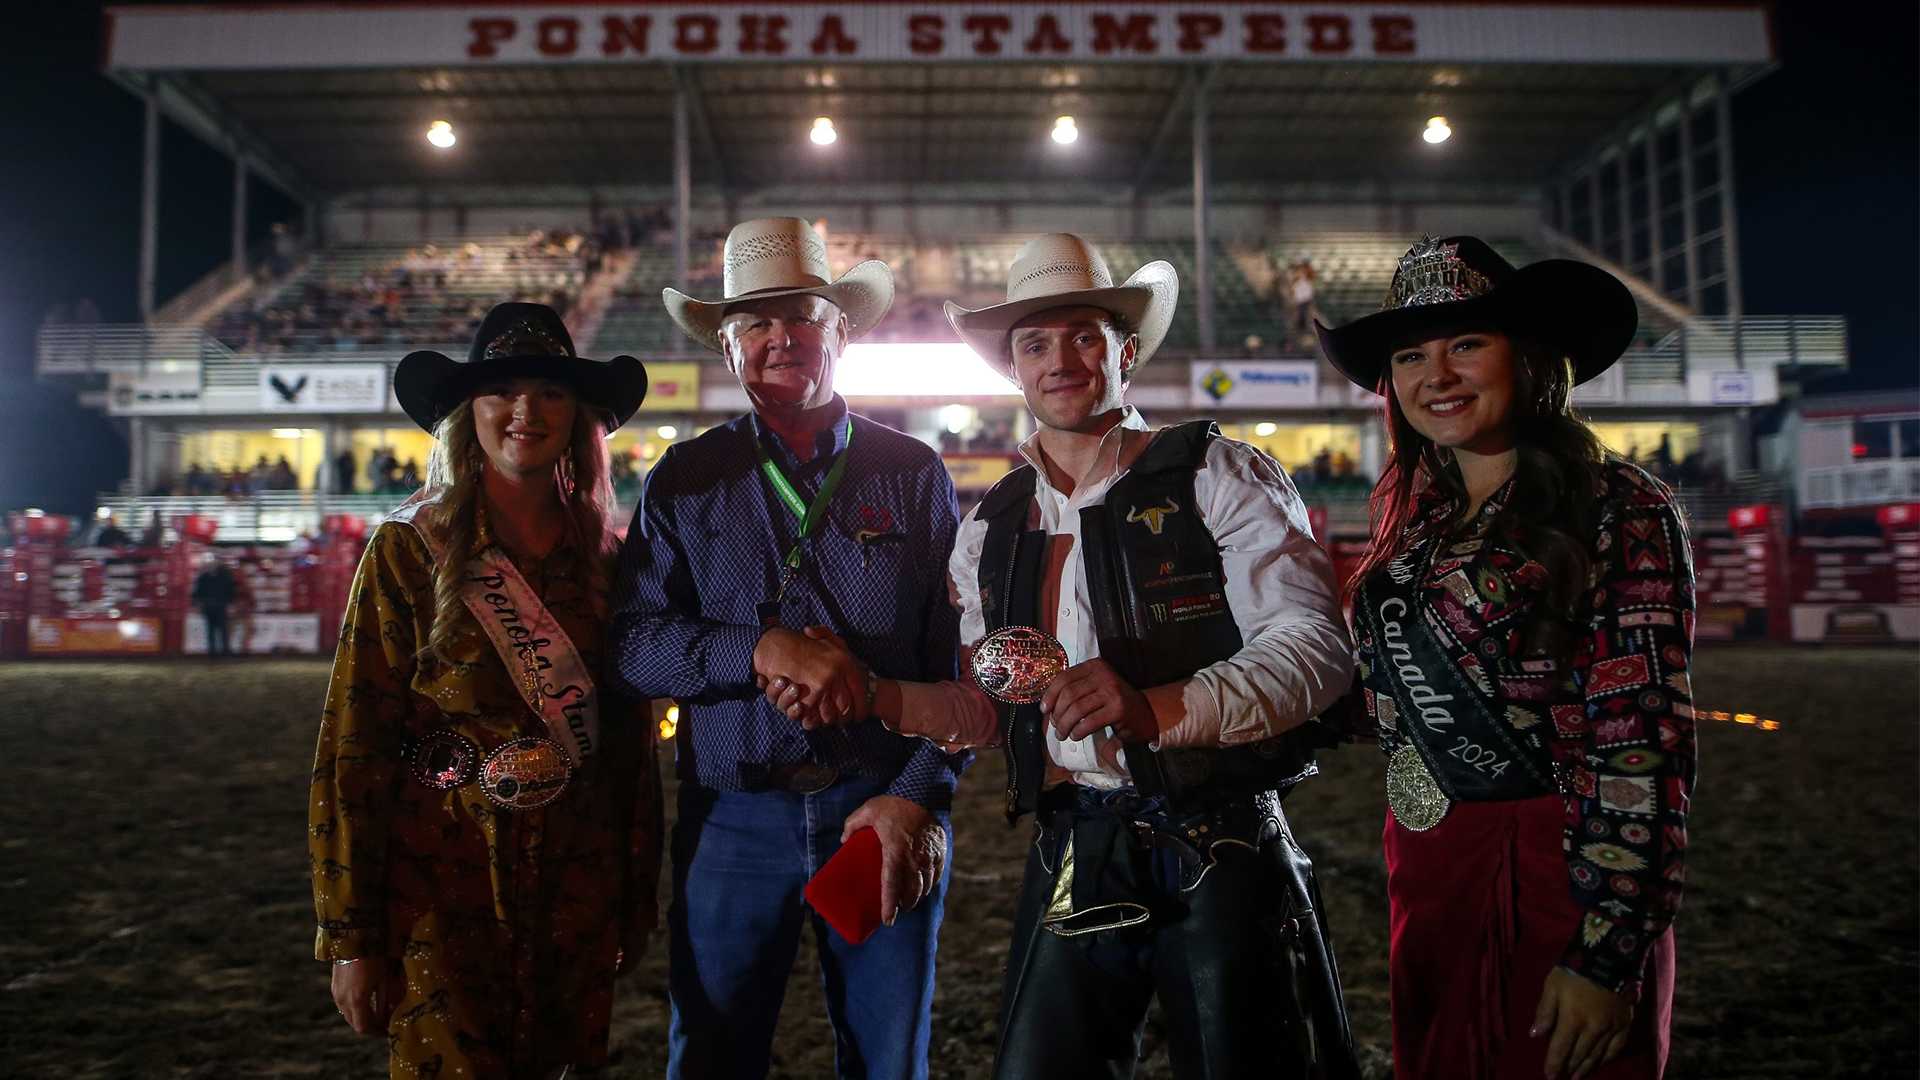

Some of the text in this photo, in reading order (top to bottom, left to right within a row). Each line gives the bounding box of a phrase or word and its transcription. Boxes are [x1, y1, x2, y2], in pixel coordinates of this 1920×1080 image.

[467, 12, 1417, 57] PONOKA STAMPEDE
[461, 572, 553, 675] Ponoka
[1380, 597, 1455, 733] Canada
[1448, 736, 1511, 780] 2024
